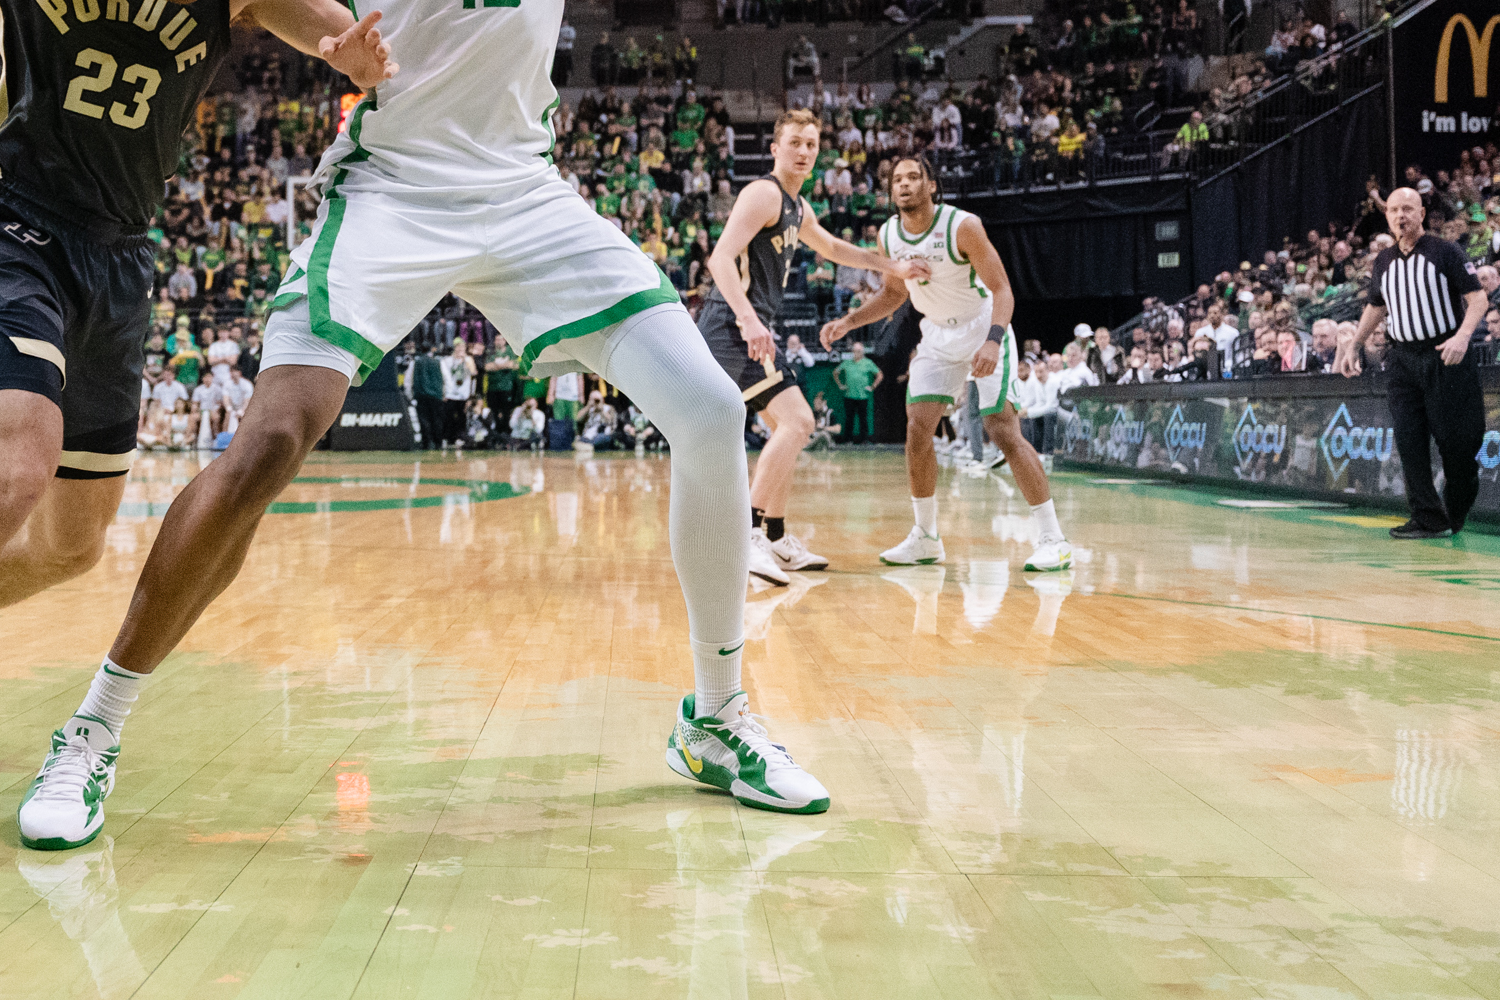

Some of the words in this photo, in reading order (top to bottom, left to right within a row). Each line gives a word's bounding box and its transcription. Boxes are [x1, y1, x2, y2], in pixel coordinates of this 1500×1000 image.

[62, 47, 162, 130] 23
[1421, 109, 1457, 133] i'm
[339, 412, 403, 427] BI-MART
[1170, 421, 1207, 450] OCCU
[1239, 424, 1287, 455] OCCU
[1331, 425, 1395, 463] OCCU
